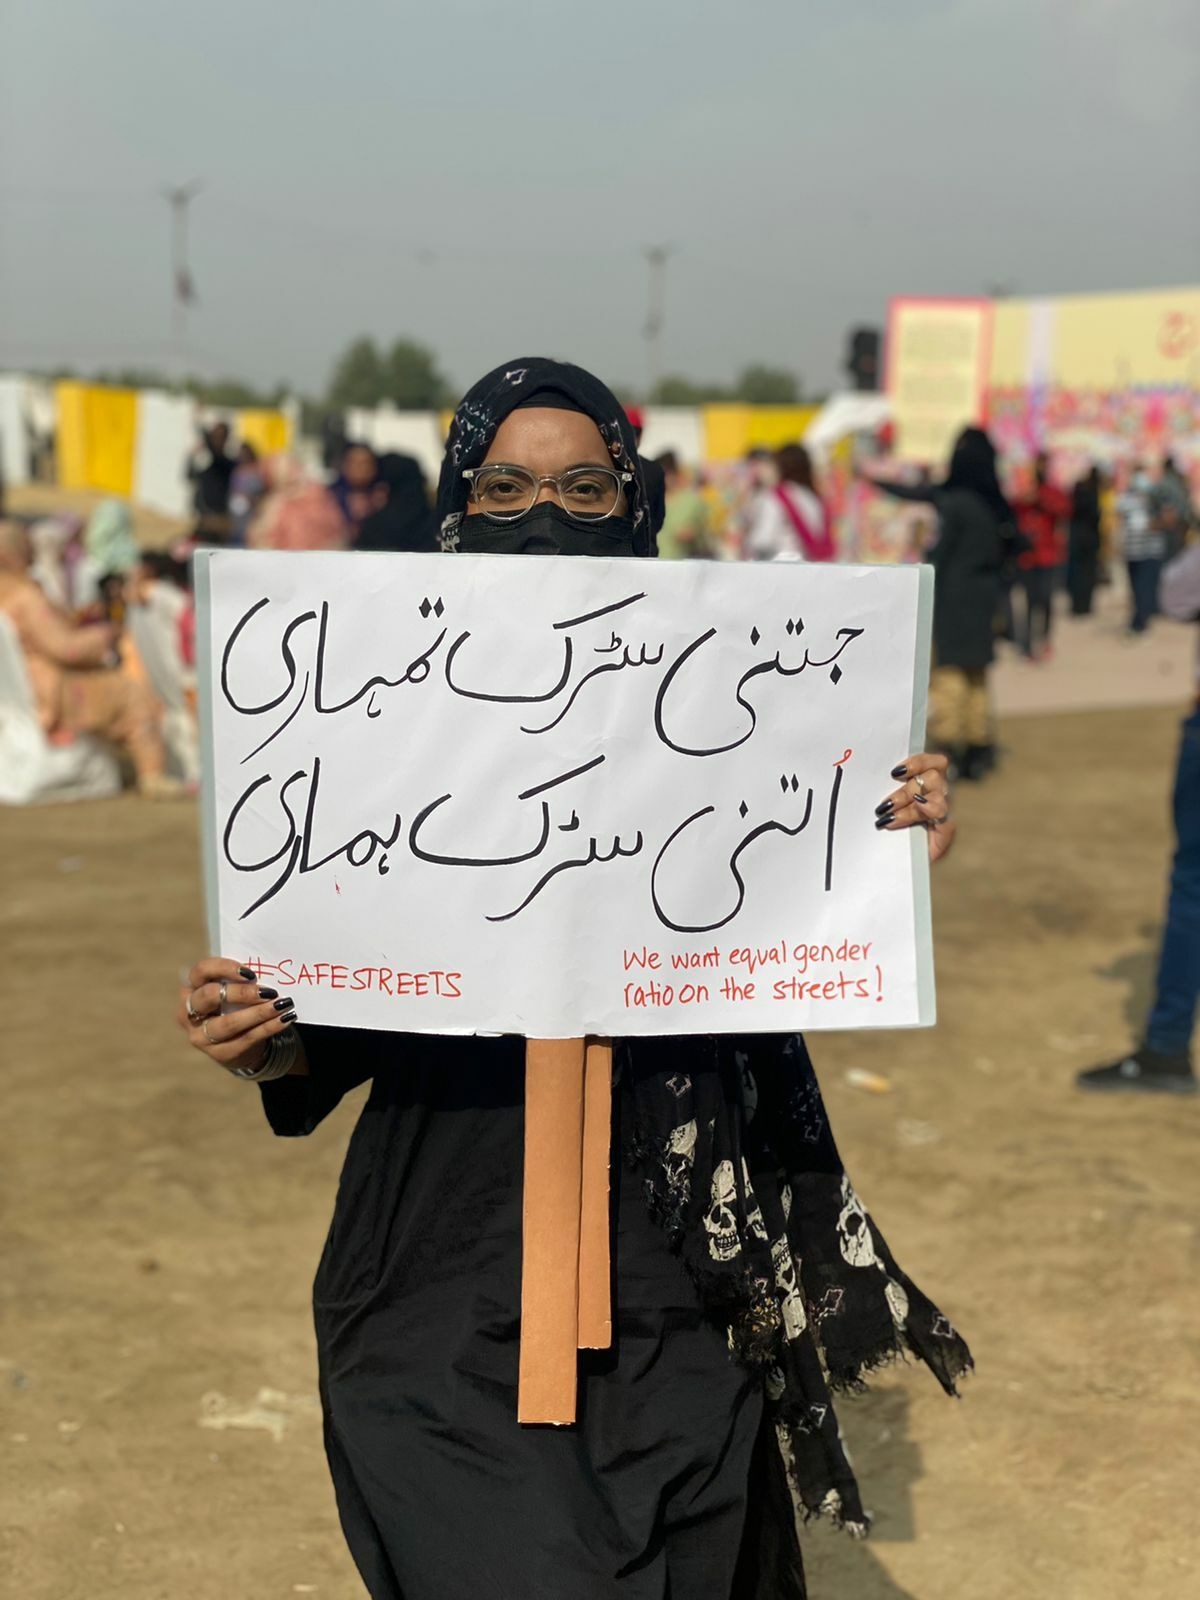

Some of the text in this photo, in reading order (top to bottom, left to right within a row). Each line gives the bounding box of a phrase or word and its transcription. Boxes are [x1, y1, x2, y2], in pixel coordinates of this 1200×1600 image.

[220, 591, 865, 764] جتنی سڑک تمہاری
[222, 756, 402, 919] ہماری
[409, 755, 643, 921] سڑک
[244, 956, 462, 998] #SAFESTREETS
[623, 939, 873, 974] We want equal gender
[623, 965, 884, 1007] ratio on the streets!
